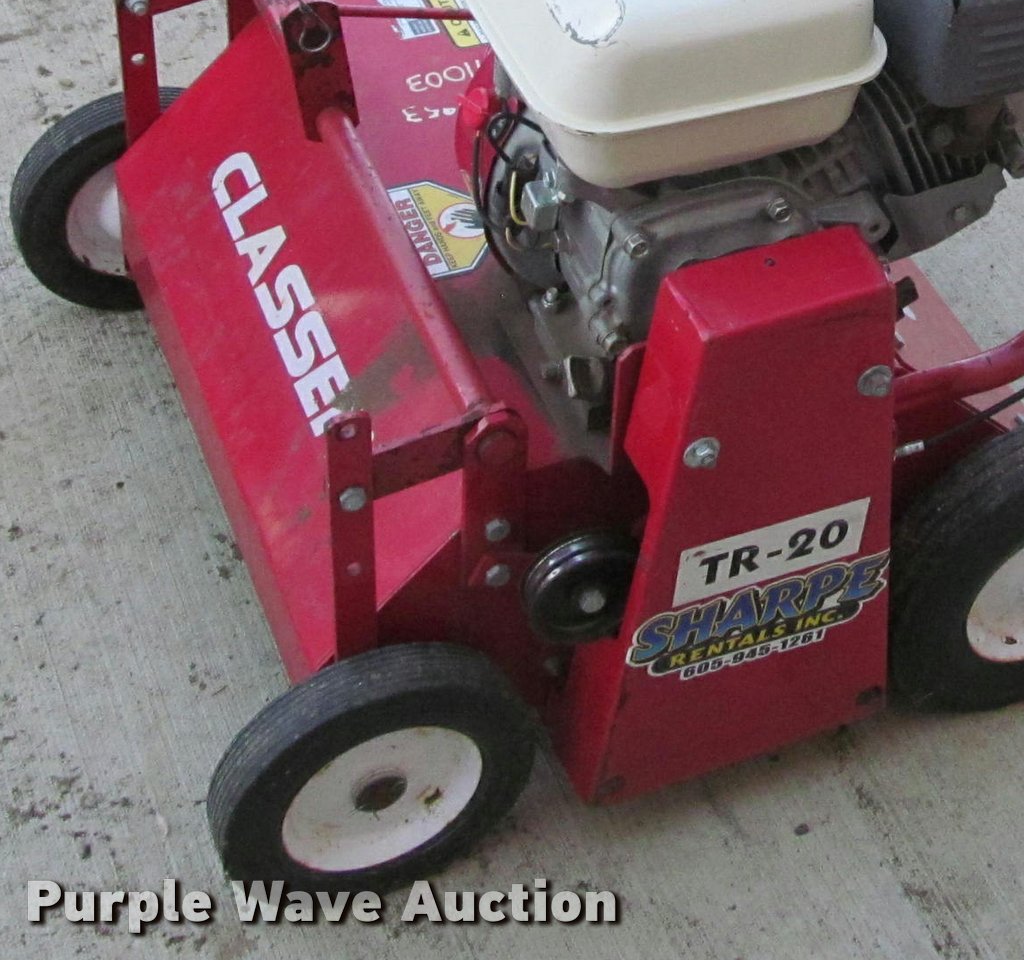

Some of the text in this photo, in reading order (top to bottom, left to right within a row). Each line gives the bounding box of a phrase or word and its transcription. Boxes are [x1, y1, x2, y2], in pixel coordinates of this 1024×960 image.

[393, 197, 443, 267] DANGER
[699, 519, 849, 585] TR-20
[630, 552, 889, 663] SHARPE
[669, 610, 843, 668] RENTALS INC.
